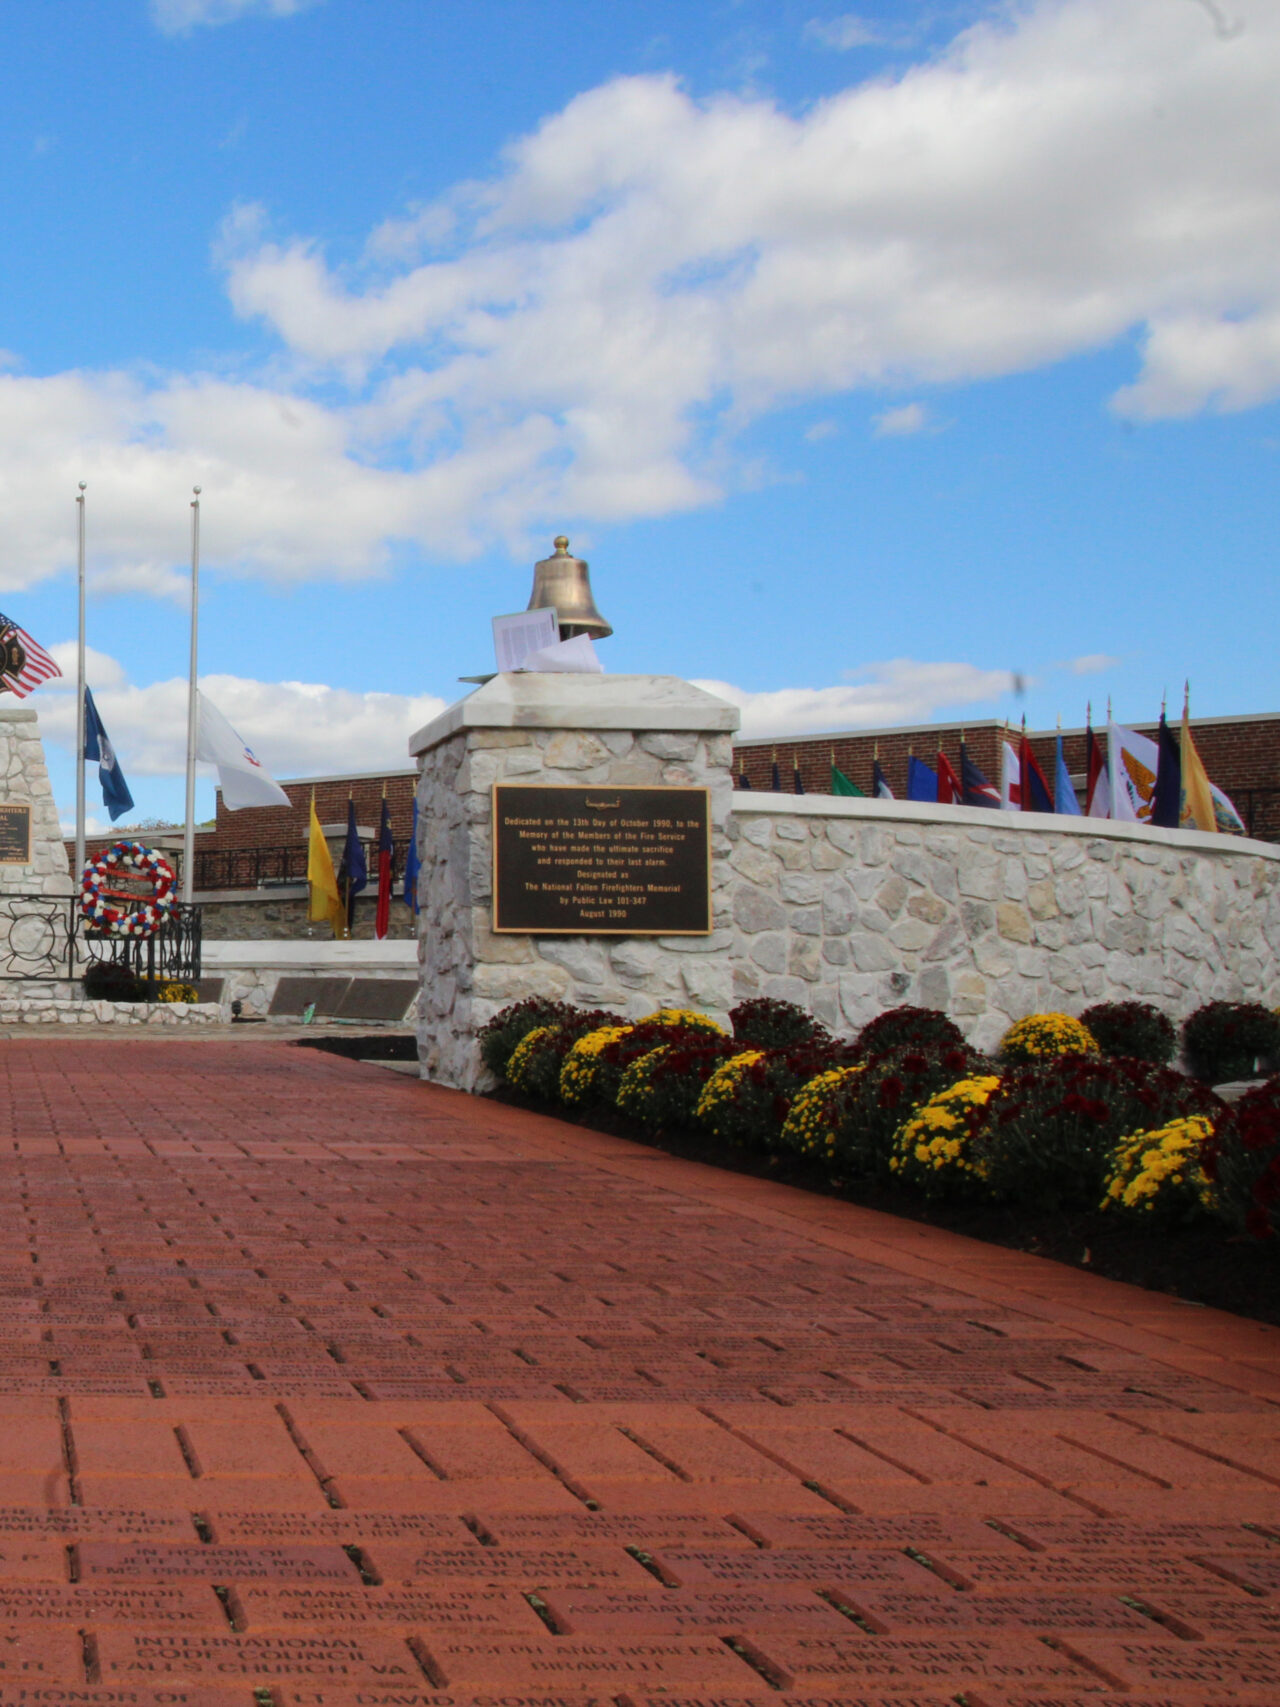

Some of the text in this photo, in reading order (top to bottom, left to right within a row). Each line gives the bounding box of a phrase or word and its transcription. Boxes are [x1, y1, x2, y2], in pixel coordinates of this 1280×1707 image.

[593, 819, 606, 827] Day
[610, 819, 617, 827] of
[621, 819, 649, 827] October
[520, 831, 548, 840] Memory
[555, 858, 592, 866] responded
[607, 858, 624, 866] their
[578, 871, 616, 879] Designated
[542, 883, 572, 891] National
[602, 884, 643, 893] Firefighters
[560, 897, 568, 905] by
[617, 897, 647, 905] 101-347
[580, 910, 605, 919] August
[133, 1636, 360, 1649] INTERNATIONAL
[370, 1664, 410, 1676] VA
[20, 1688, 139, 1703] HONOR
